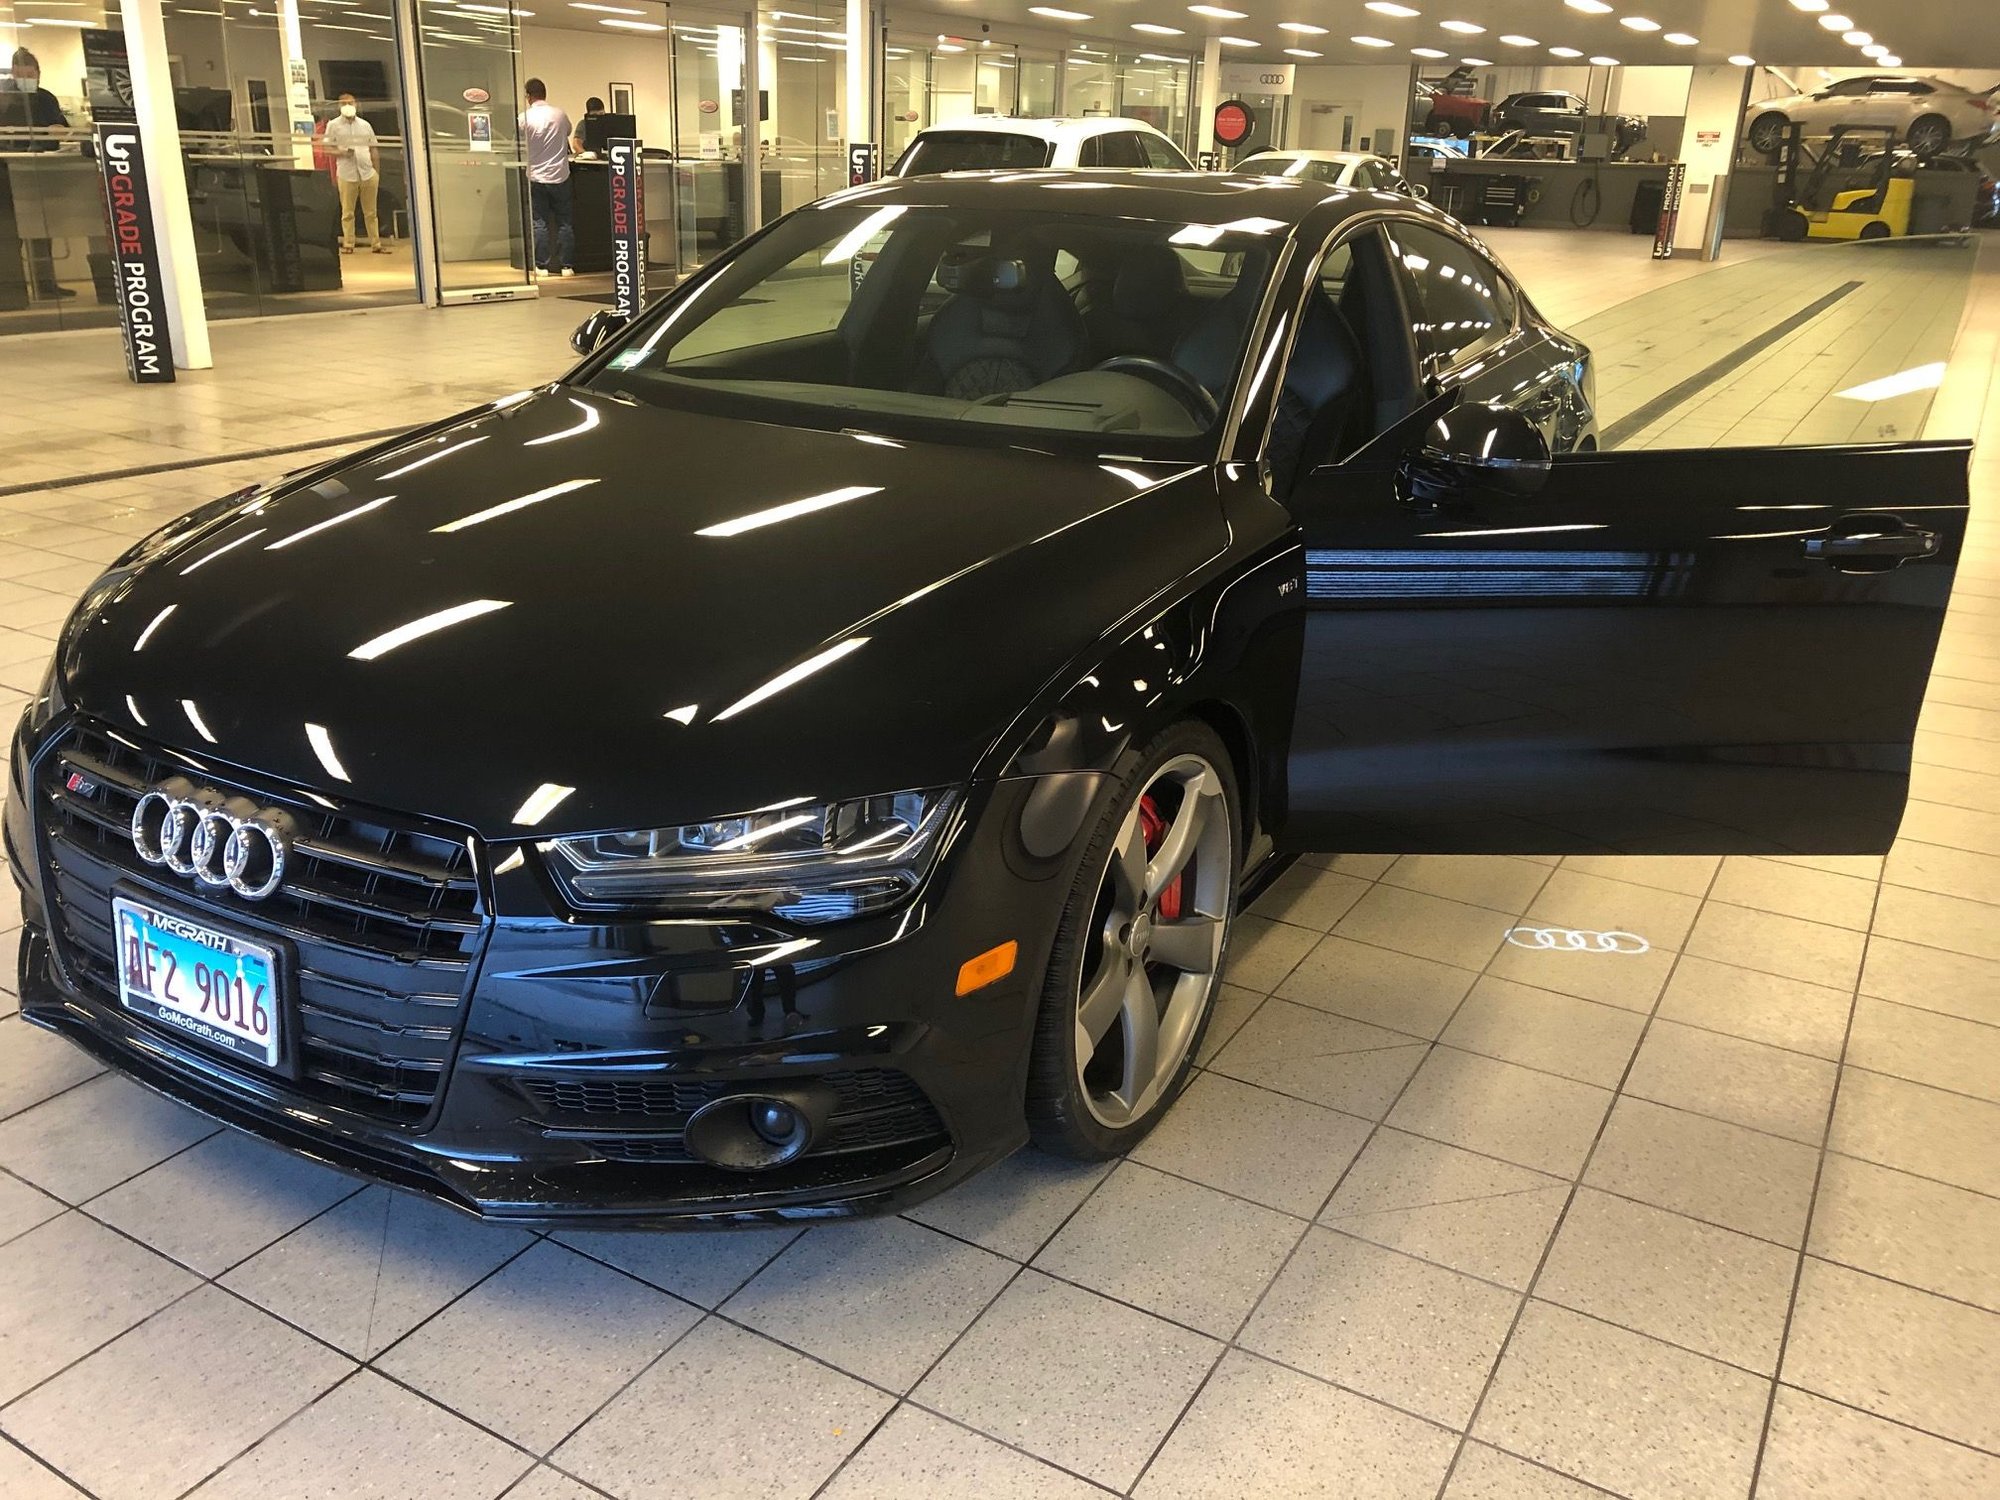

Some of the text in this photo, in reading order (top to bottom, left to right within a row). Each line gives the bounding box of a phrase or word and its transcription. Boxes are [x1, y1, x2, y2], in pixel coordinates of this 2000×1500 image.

[1663, 166, 1676, 210] PROGRAM
[1673, 166, 1685, 210] PROGRAM
[638, 240, 646, 313] PROGRA
[124, 262, 160, 374] PROGRAM
[158, 1007, 235, 1047] GoMcGrath.com
[195, 962, 268, 1036] 9016
